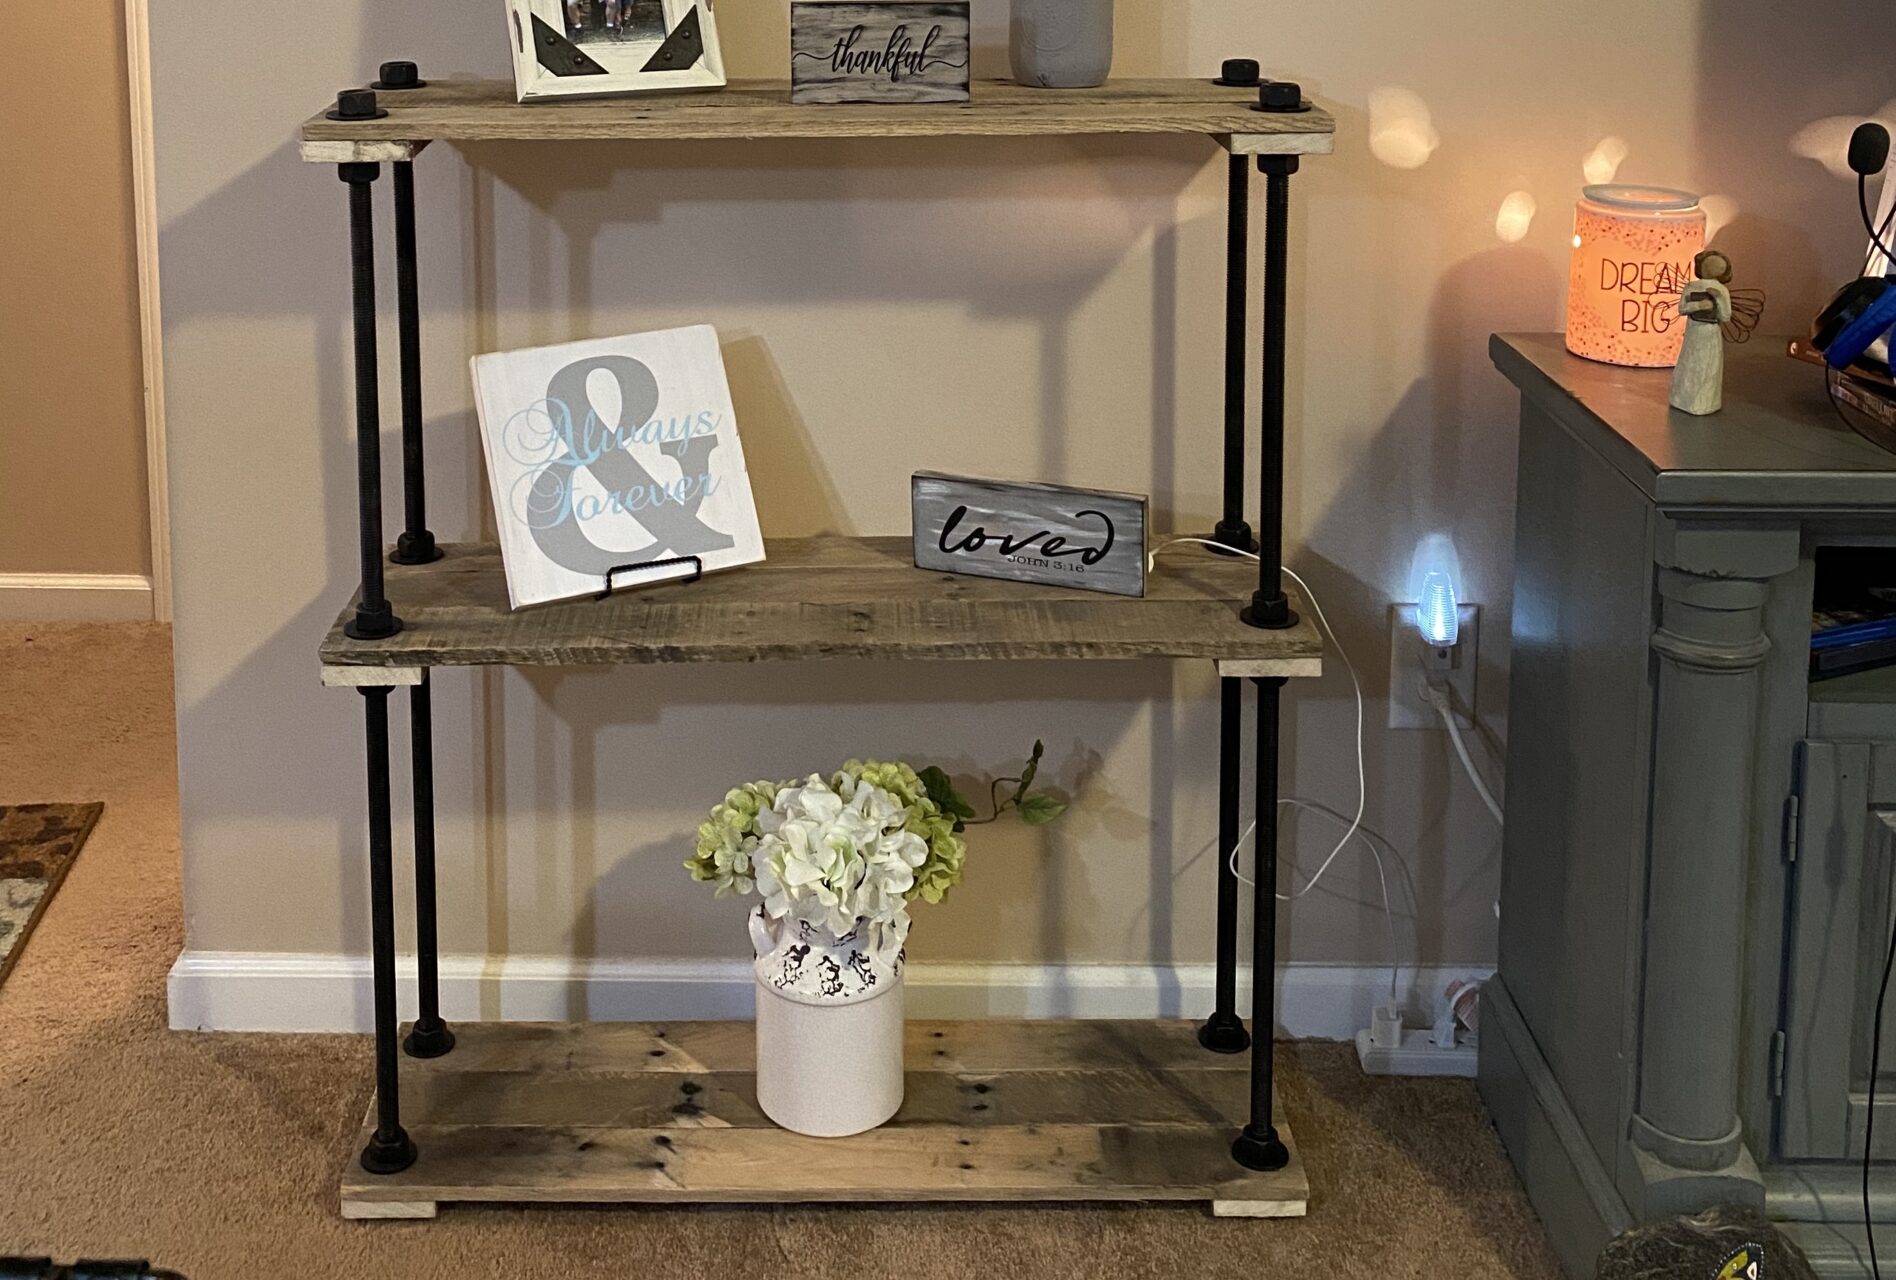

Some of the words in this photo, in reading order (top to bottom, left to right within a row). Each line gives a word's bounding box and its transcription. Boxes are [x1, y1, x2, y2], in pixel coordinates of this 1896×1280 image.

[793, 24, 968, 83] thankful
[1600, 258, 1692, 294] DREAM
[1621, 299, 1671, 334] BIG
[503, 397, 722, 466] Always
[510, 459, 722, 530] Forever
[939, 505, 1115, 566] loved
[1007, 554, 1049, 568] JOHN
[1053, 561, 1085, 573] 3:16
